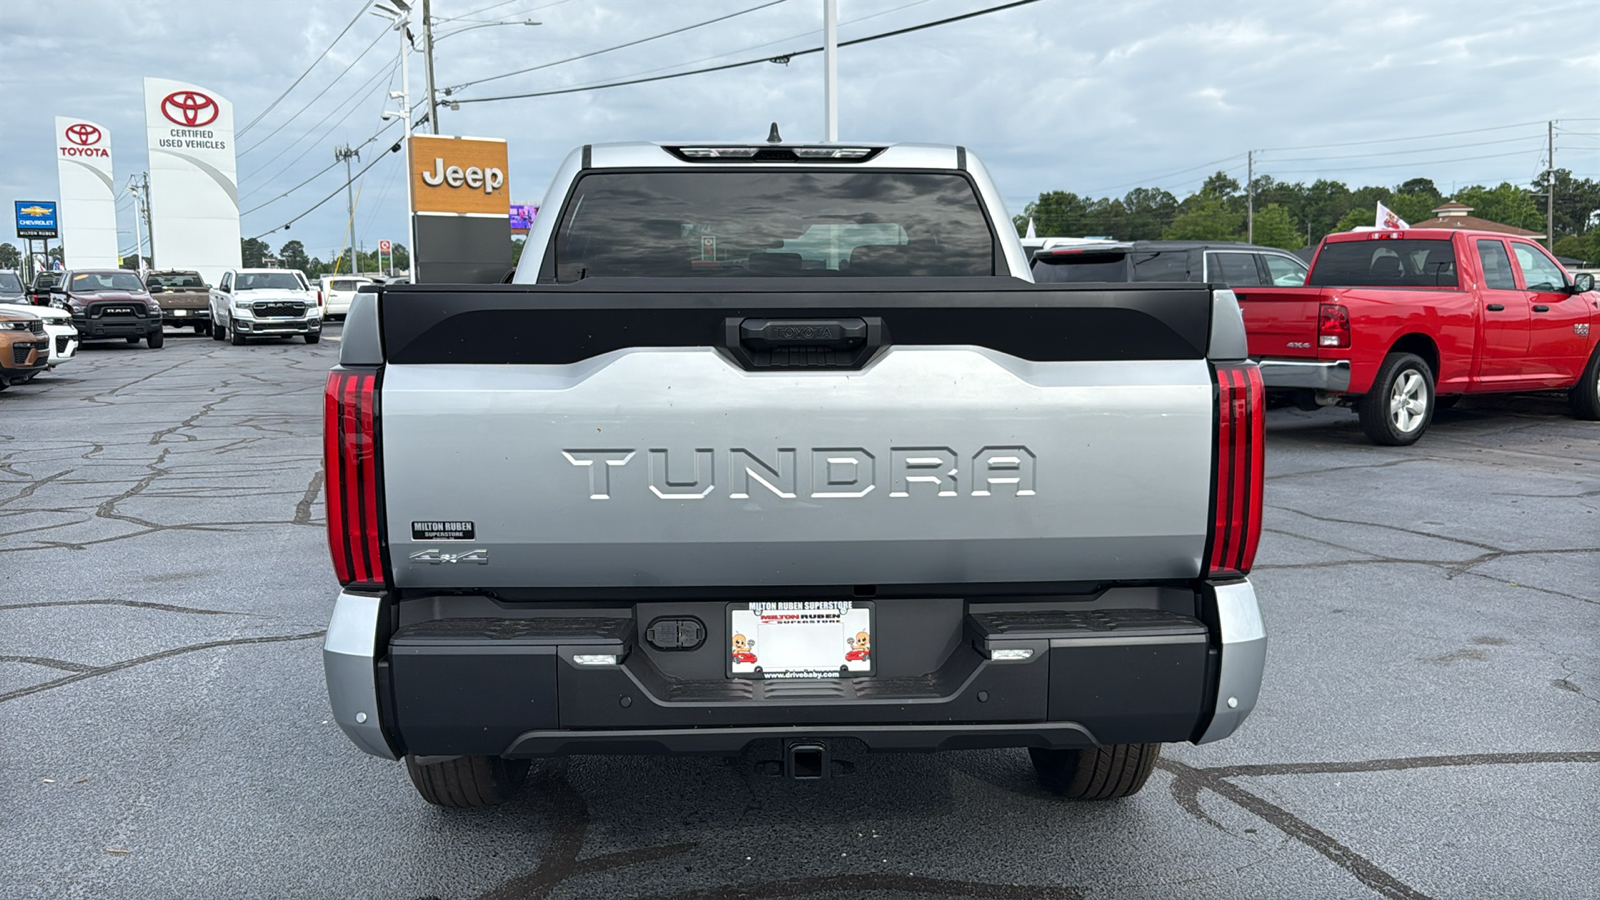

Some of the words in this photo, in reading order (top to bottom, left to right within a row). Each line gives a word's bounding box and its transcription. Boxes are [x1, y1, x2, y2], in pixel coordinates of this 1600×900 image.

[170, 129, 213, 138] CERTIFIED
[159, 140, 182, 148] USED
[185, 140, 225, 149] VEHICLES
[60, 147, 109, 157] TOYOTA
[422, 158, 504, 194] Jeep
[775, 327, 832, 338] TOYOTA
[562, 446, 1037, 500] TUNDRA
[414, 523, 443, 531] MILTON
[445, 523, 472, 531] RUBEN
[749, 602, 776, 610] MILTON
[778, 602, 802, 610] RUBEN
[804, 601, 852, 609] SUPERSTORE
[764, 670, 839, 678] www.drivebaby.com
